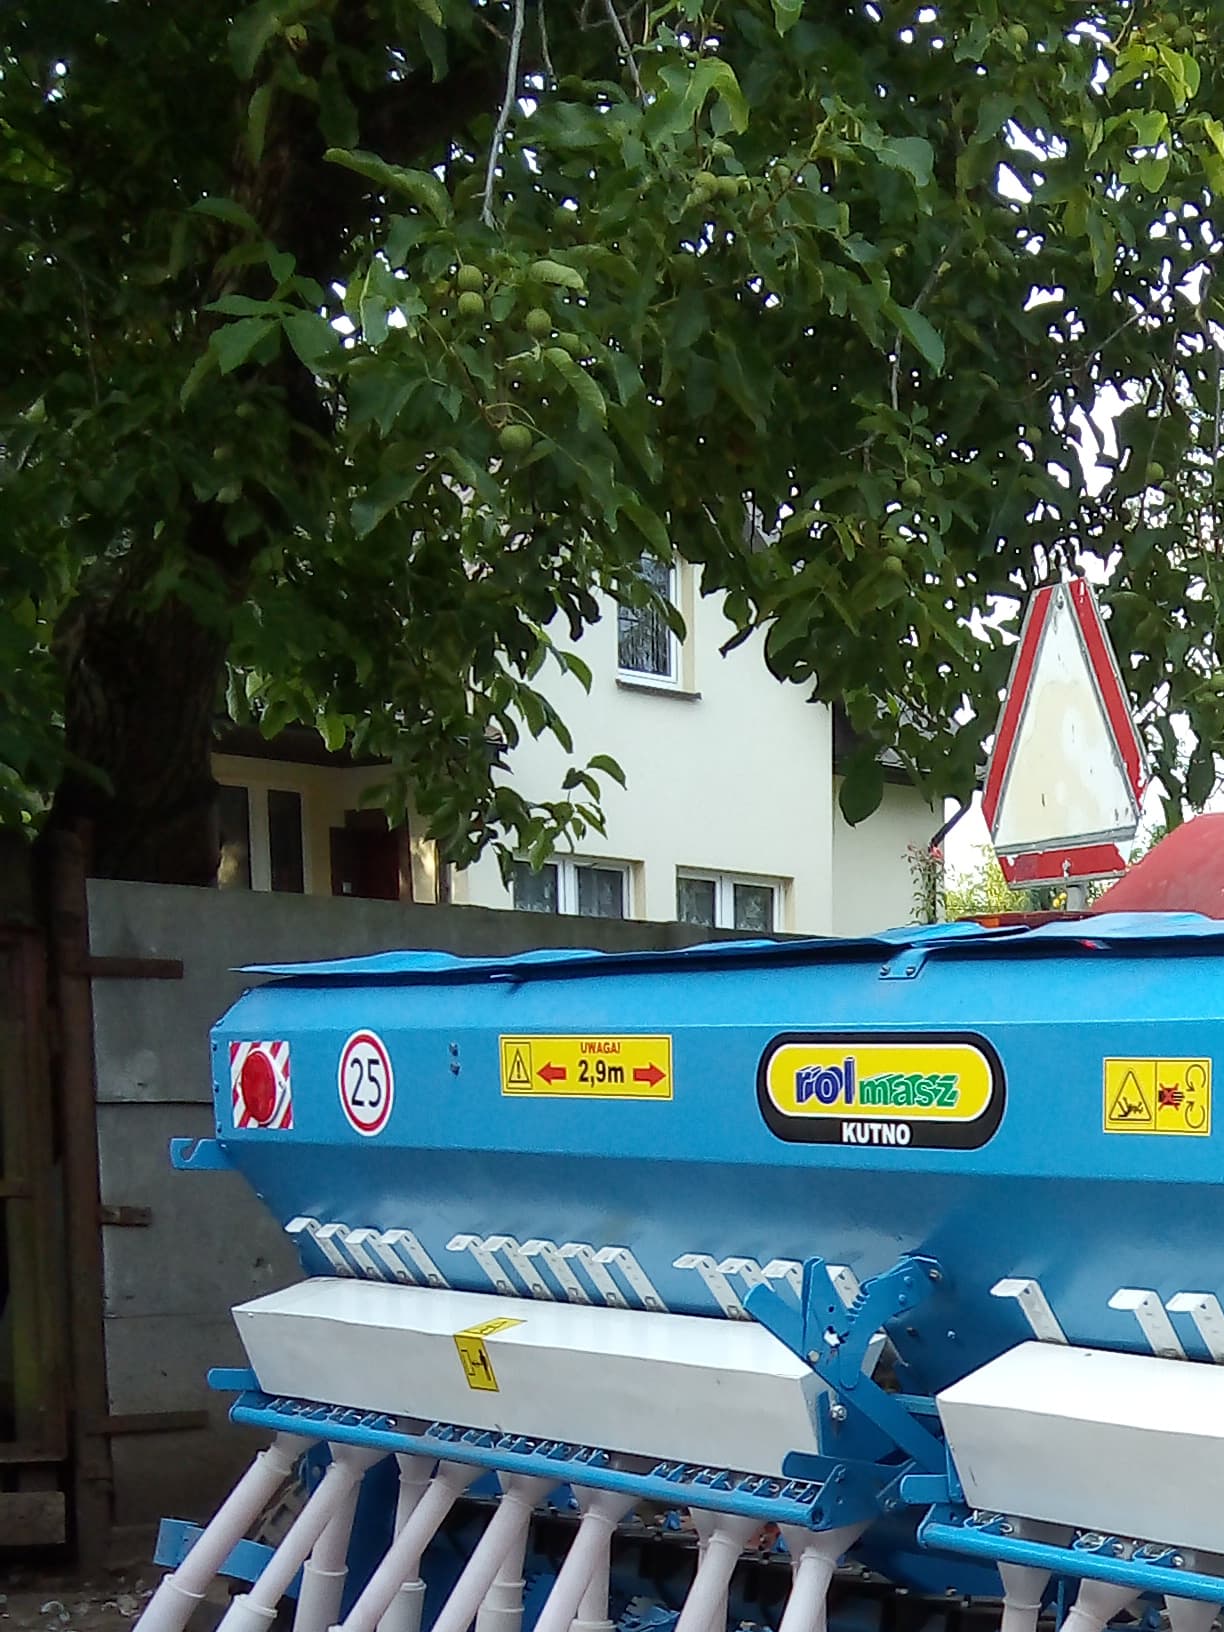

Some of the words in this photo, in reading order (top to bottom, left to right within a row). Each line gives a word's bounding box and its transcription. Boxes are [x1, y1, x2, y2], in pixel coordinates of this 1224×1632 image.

[350, 1057, 382, 1107] 25
[577, 1059, 625, 1088] 2,9m
[841, 1121, 911, 1145] KUTNO
